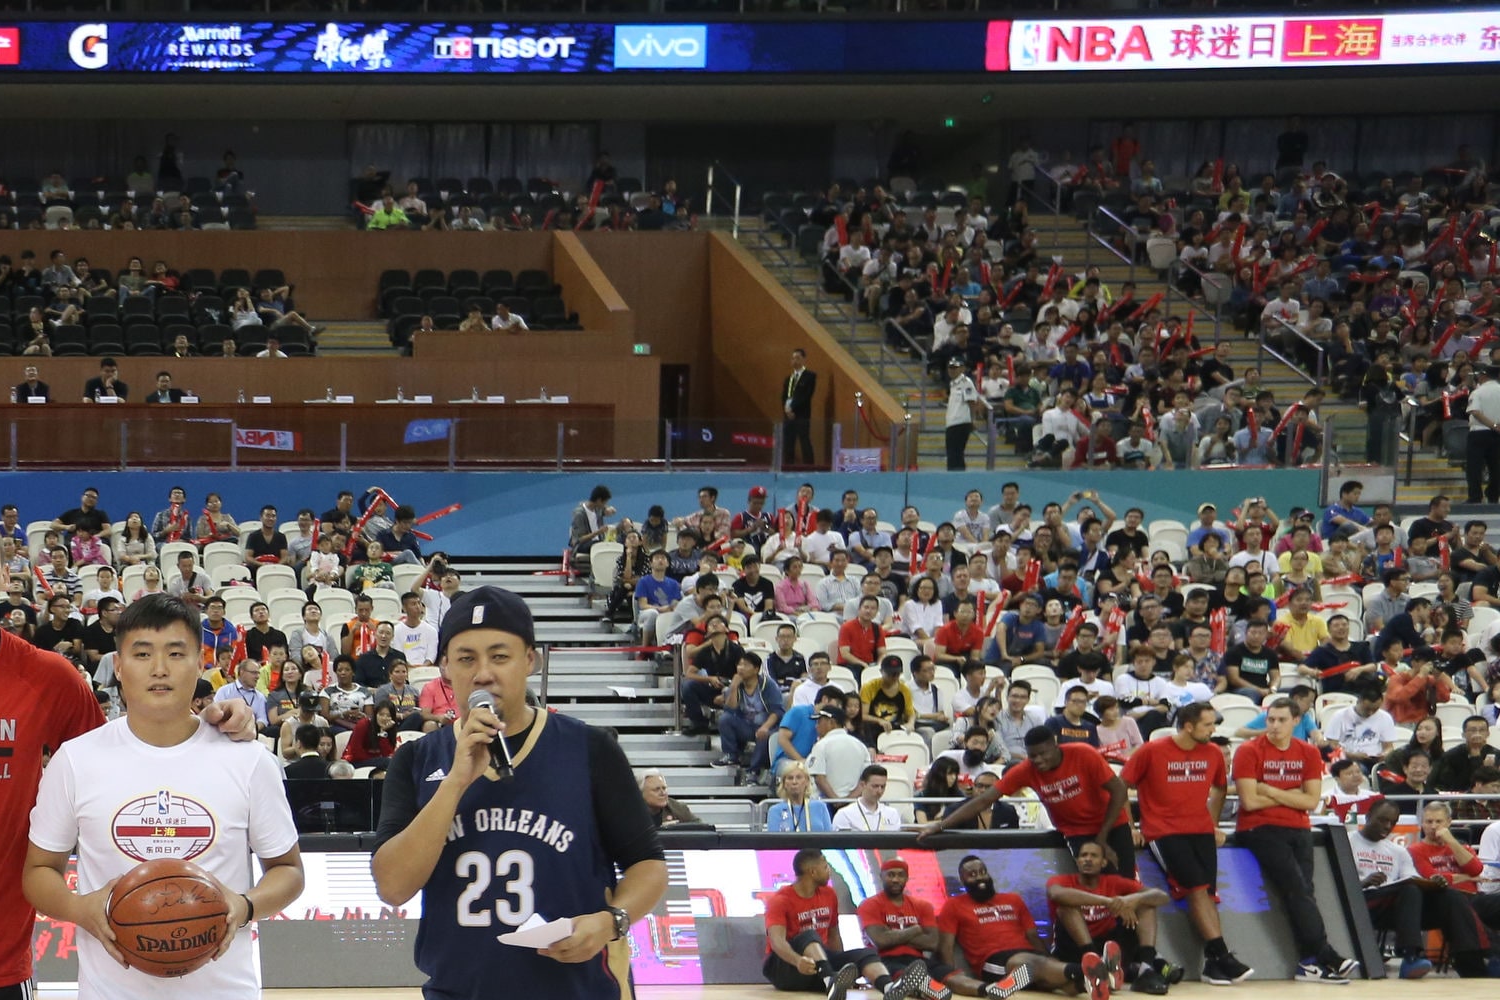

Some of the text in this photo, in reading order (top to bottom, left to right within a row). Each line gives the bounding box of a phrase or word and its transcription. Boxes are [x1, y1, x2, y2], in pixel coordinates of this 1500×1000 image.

[180, 25, 240, 42] Marriott
[1047, 23, 1276, 62] NBA 球迷日
[1287, 22, 1377, 57] 上海
[68, 24, 108, 69] G
[167, 43, 253, 57] REWARDS
[471, 37, 575, 59] TISSOT
[621, 33, 700, 57] vivo
[1167, 760, 1207, 770] HOUSTON
[1263, 760, 1303, 769] HOUSTON
[141, 817, 162, 825] NBA
[151, 827, 176, 837] 上海
[474, 807, 574, 853] ORLEANS
[456, 849, 535, 928] 23
[797, 906, 830, 921] HOUSTON
[136, 925, 217, 953] SPALDING
